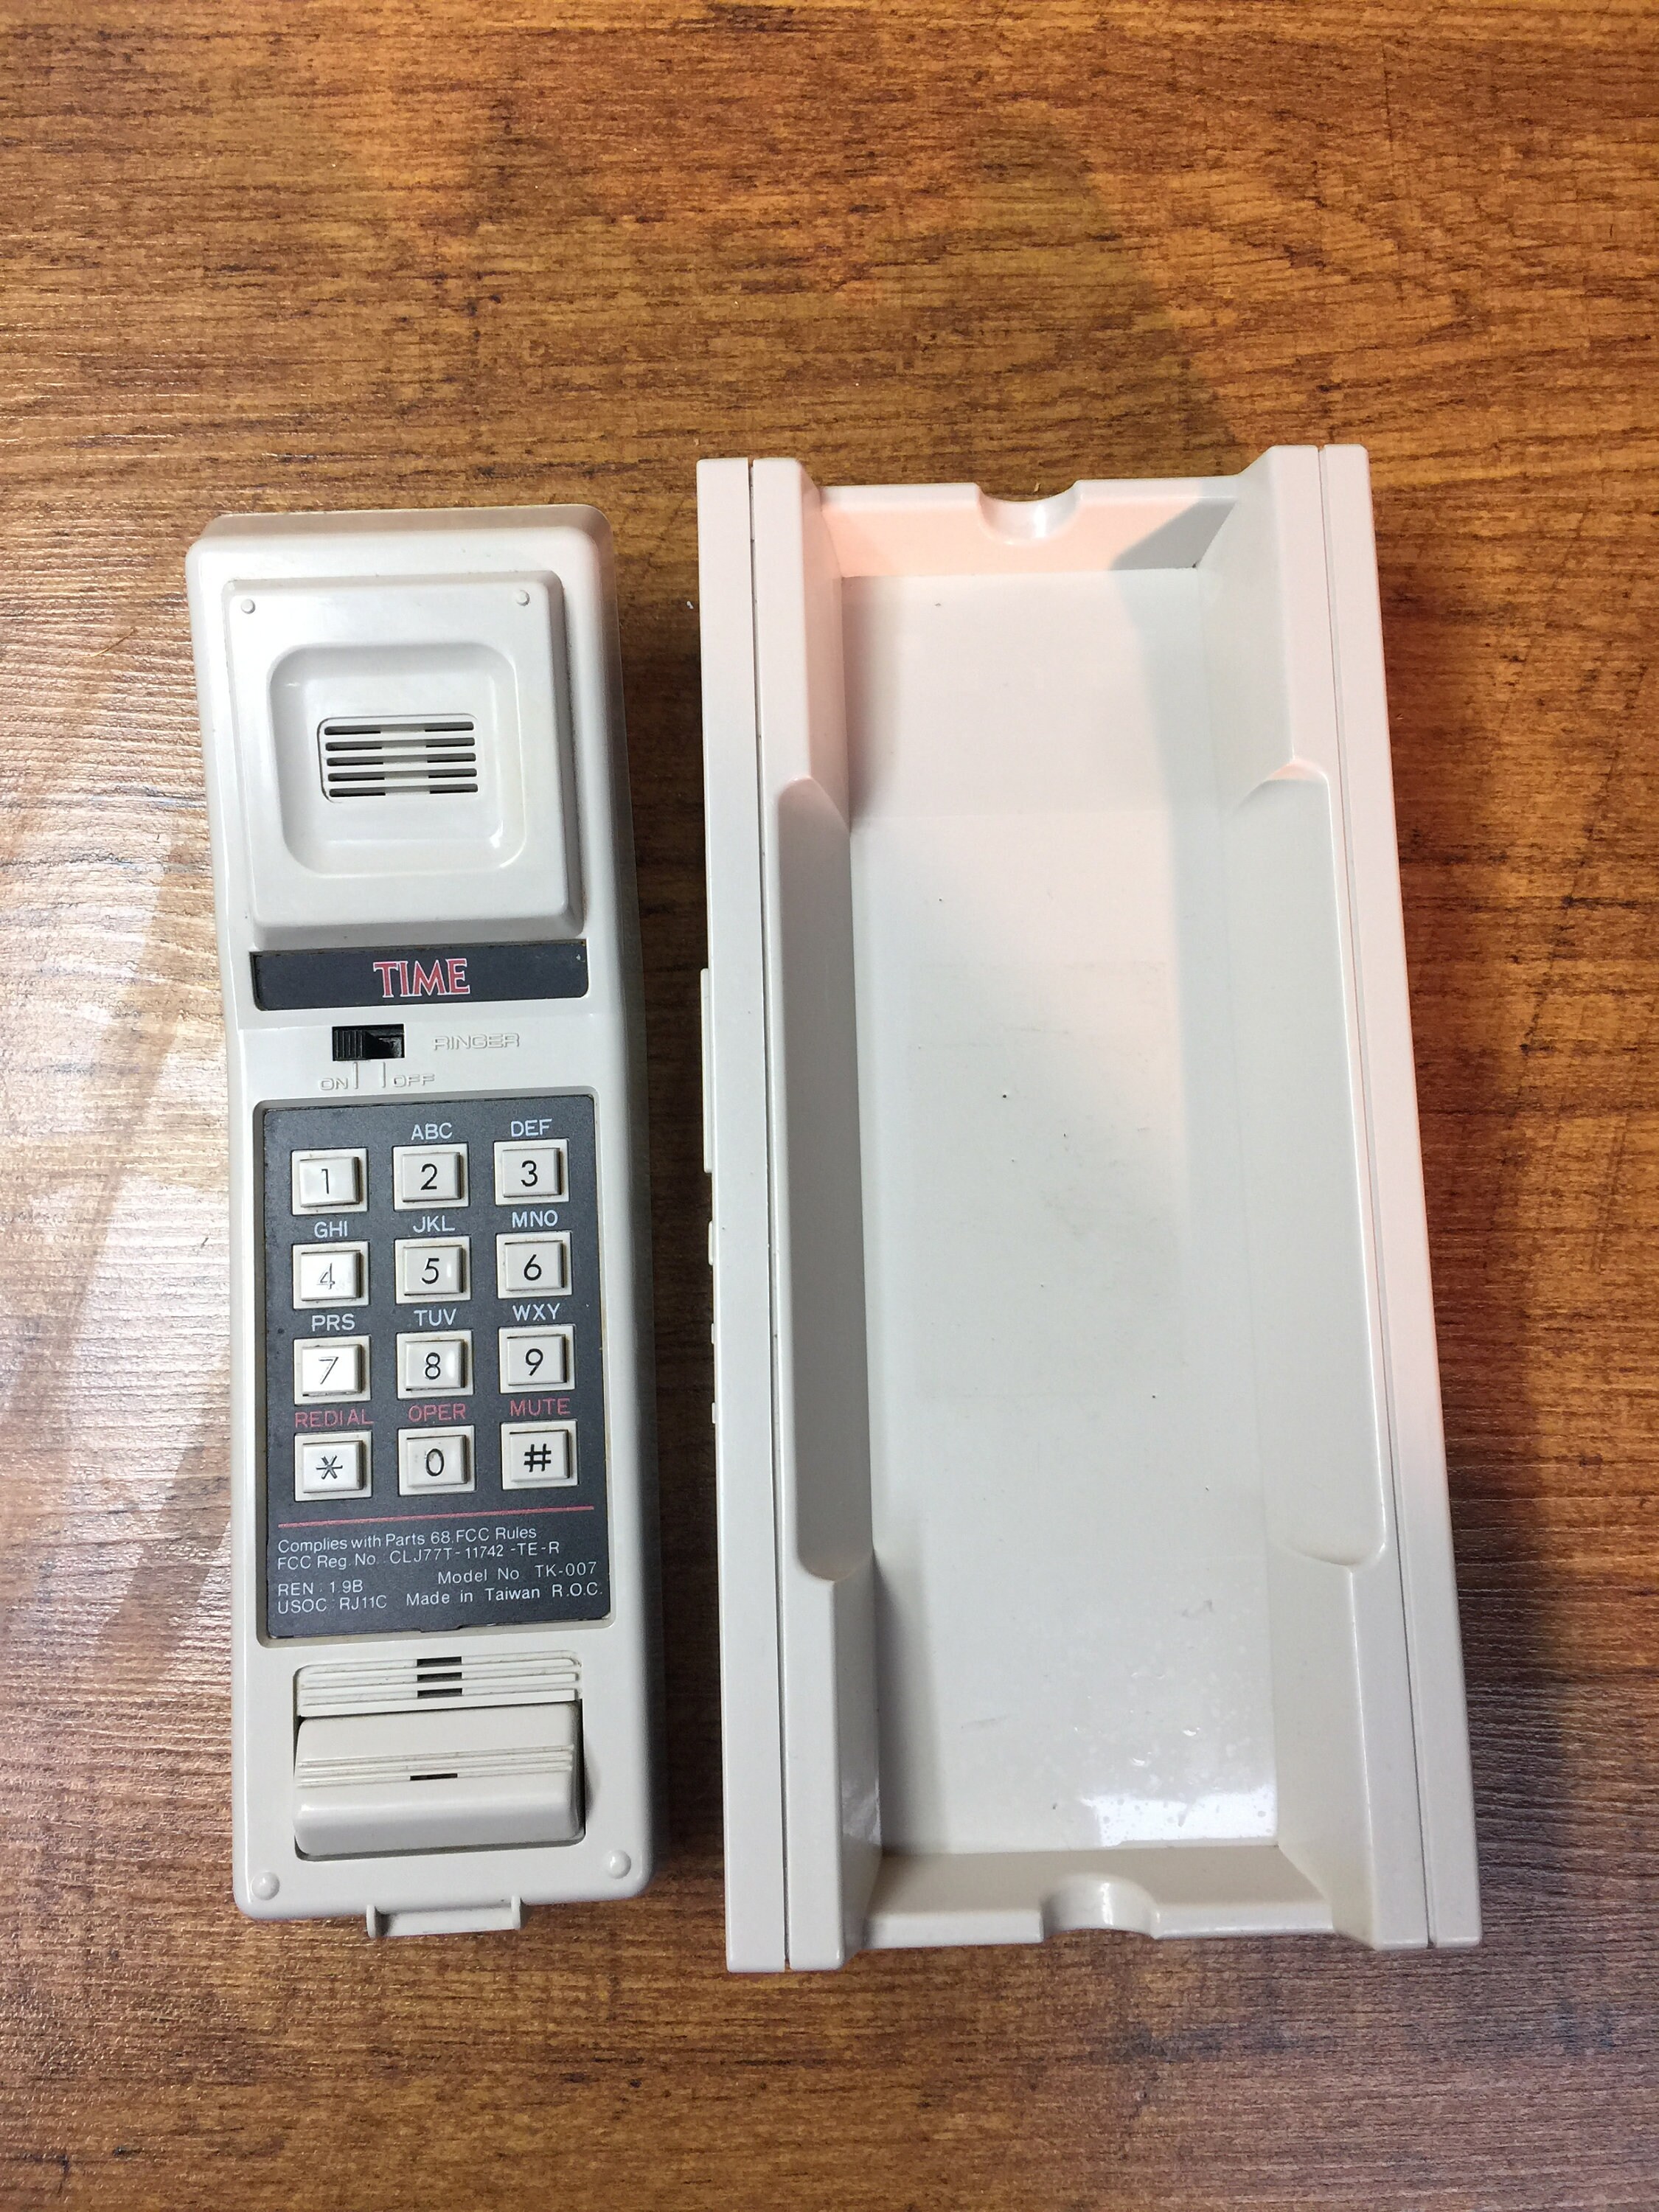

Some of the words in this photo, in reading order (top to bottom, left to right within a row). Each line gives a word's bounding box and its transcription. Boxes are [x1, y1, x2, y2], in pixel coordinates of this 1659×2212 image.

[372, 958, 470, 998] TIME
[434, 1032, 521, 1051] RINGER
[319, 1077, 349, 1091] ON
[392, 1074, 436, 1089] OFF
[411, 1122, 453, 1141] ABC
[510, 1118, 552, 1137] DEF
[320, 1168, 330, 1194] 1
[420, 1162, 438, 1191] 2
[520, 1159, 538, 1187] 3
[413, 1215, 456, 1234] JKL
[512, 1209, 558, 1228] MNO
[313, 1220, 349, 1239] GHI
[316, 1262, 336, 1290] 4
[421, 1257, 439, 1284] 5
[523, 1253, 542, 1281] 6
[311, 1313, 355, 1332] PRS
[414, 1309, 456, 1326] TUV
[512, 1303, 561, 1321] WXY
[318, 1355, 339, 1385] 7
[424, 1352, 442, 1380] 8
[525, 1348, 543, 1377] 9
[408, 1402, 466, 1423] OPER
[510, 1397, 571, 1417] MUTE
[294, 1408, 374, 1429] REDIAL
[425, 1447, 445, 1477] 0
[524, 1443, 552, 1472] #
[278, 1537, 347, 1554] Complies
[351, 1534, 381, 1548] with
[386, 1532, 425, 1547] Parts
[456, 1528, 490, 1543] FCC
[495, 1526, 537, 1540] Rules
[277, 1555, 311, 1571] FCC
[438, 1568, 487, 1585] Model
[535, 1562, 597, 1579] TK-007
[340, 1595, 387, 1610] RJ11C
[406, 1591, 450, 1607] Made
[460, 1589, 473, 1603] in
[484, 1587, 540, 1601] Taiwan
